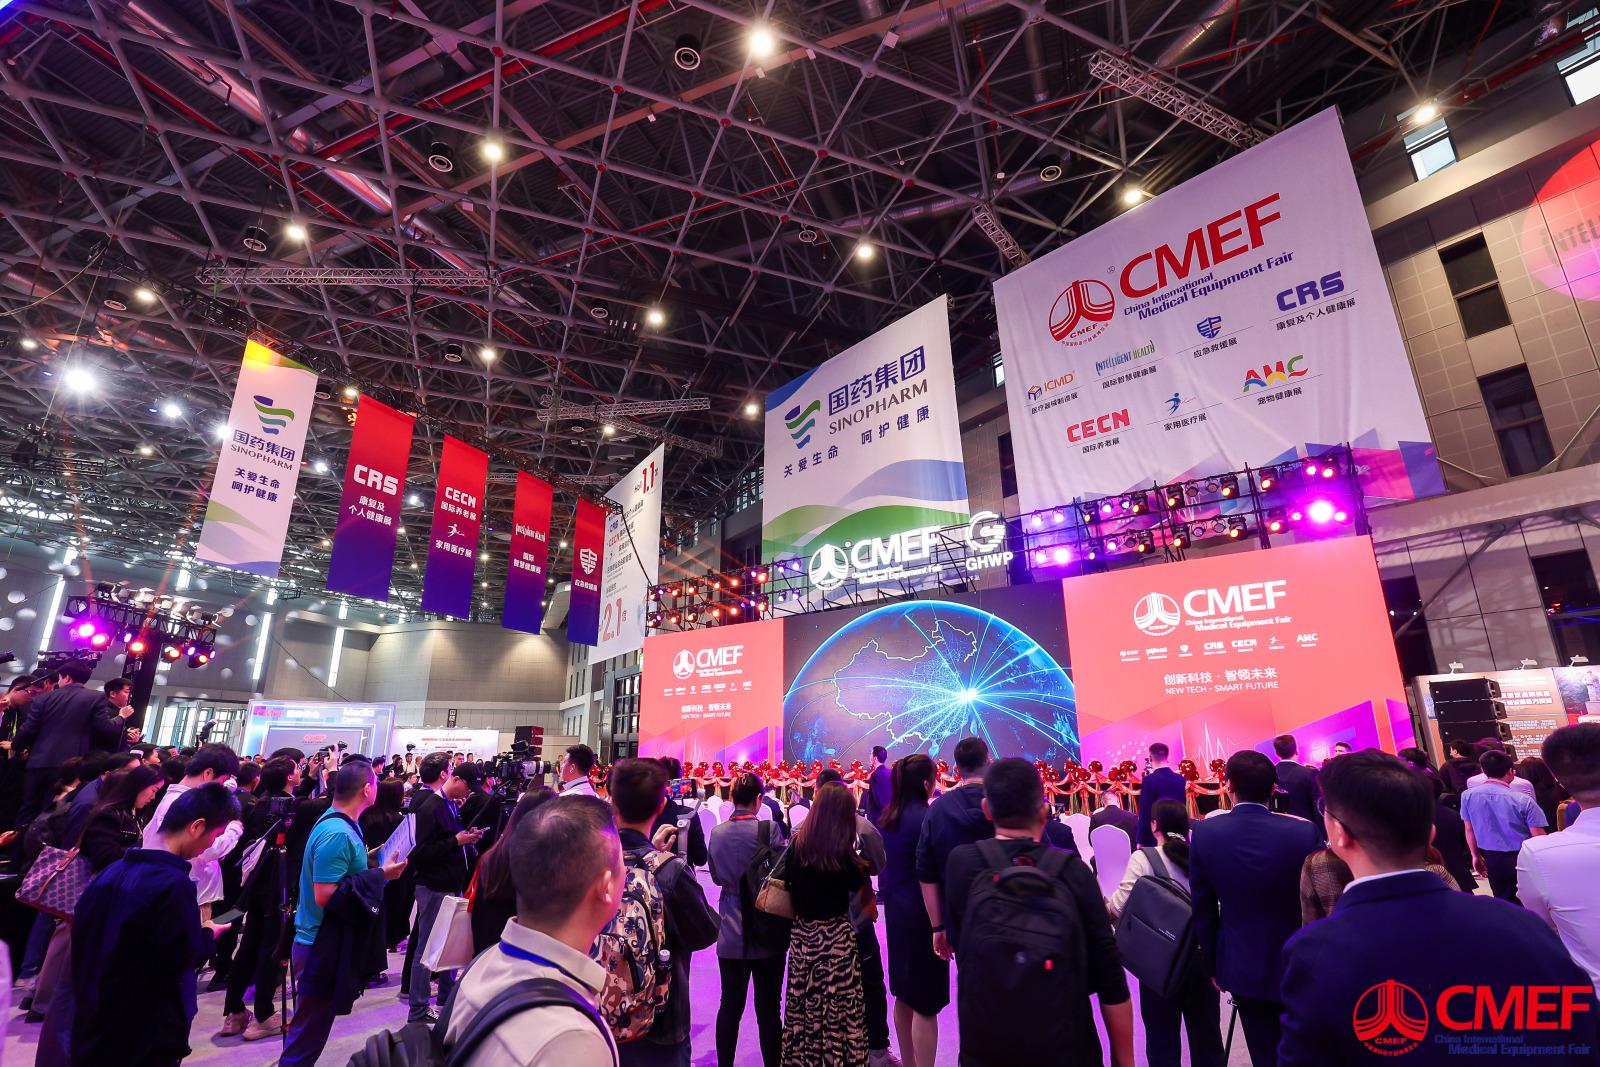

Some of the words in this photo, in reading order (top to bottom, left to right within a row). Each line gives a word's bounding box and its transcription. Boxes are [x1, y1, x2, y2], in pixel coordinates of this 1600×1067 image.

[1120, 192, 1281, 298] CMEF
[1124, 301, 1150, 316] China
[1152, 272, 1214, 306] International
[1138, 292, 1189, 320] Medical
[1191, 263, 1263, 301] Equipment
[1266, 251, 1294, 272] Fair
[1276, 270, 1345, 311] CRS
[1276, 298, 1356, 331] 康复及个人健康展
[1070, 323, 1098, 338] CMEF
[1193, 337, 1238, 358] 应急救援展
[828, 345, 926, 417] 国药集团
[1044, 373, 1074, 392] ICMD
[829, 378, 928, 435] SINOPHARM
[1257, 387, 1303, 405] 宠物健康展
[1066, 408, 1131, 443] CECN
[1164, 413, 1207, 431] 家用医疗展
[232, 429, 296, 462] 国药集团
[783, 445, 839, 479] 关爱生命
[861, 405, 930, 445] 呵护健康
[1082, 437, 1120, 454] 国际养老展
[230, 444, 293, 471] SINOPHARM
[234, 467, 281, 489] 关爱生命
[353, 465, 399, 496] CRS
[231, 480, 278, 503] 呵护健康
[445, 486, 477, 509] CECN
[348, 504, 392, 526] 个人健康展
[358, 495, 385, 512] 康复及
[435, 539, 473, 559] 家用医疗展
[851, 525, 942, 570] CMEF
[965, 551, 1014, 571] GHWP
[1183, 579, 1286, 617] CMEF
[1195, 621, 1228, 632] Medical
[1229, 617, 1274, 630] Equipment
[1275, 615, 1292, 625] Fair
[696, 645, 744, 668] CMEF
[1165, 686, 1184, 695] NEW
[1185, 685, 1207, 694] TECH
[1214, 683, 1243, 692] SMART
[1245, 681, 1279, 691] FUTURE
